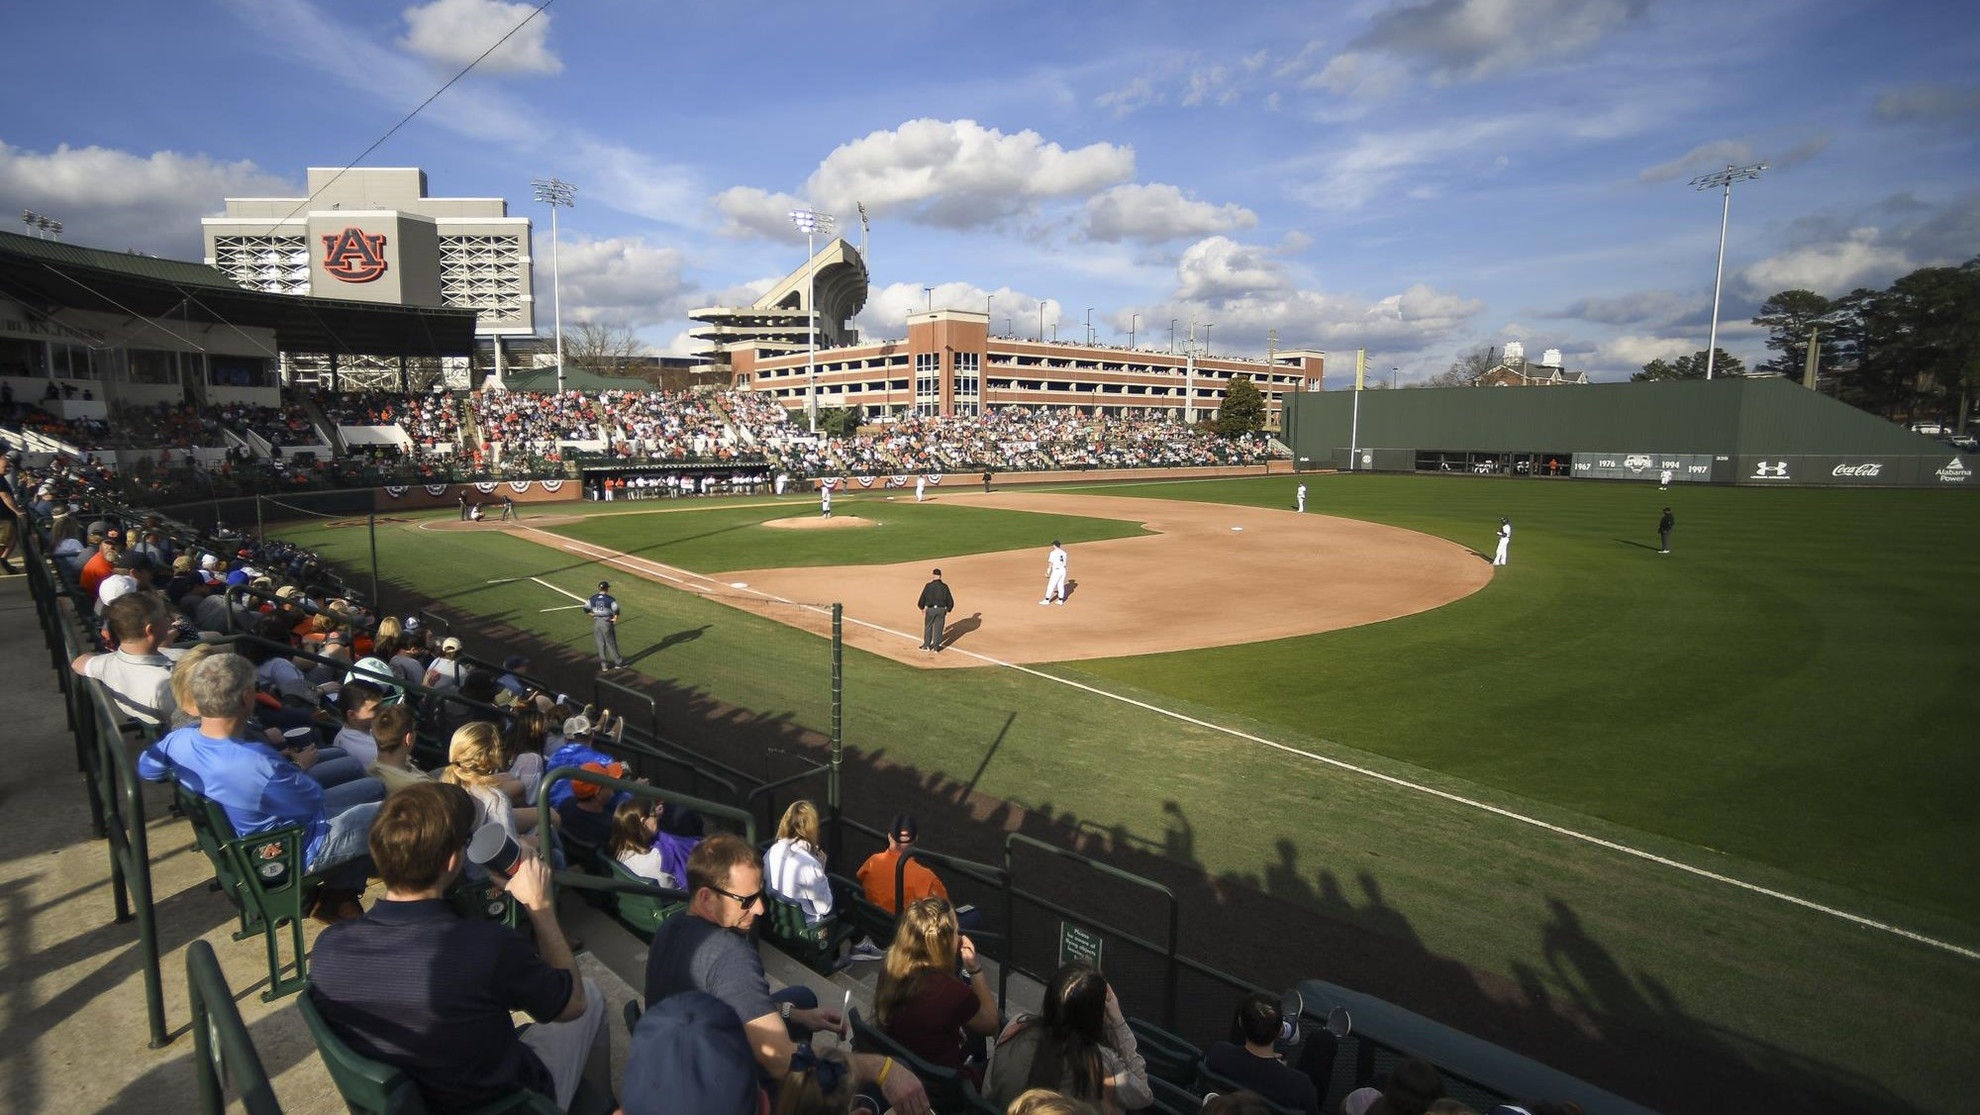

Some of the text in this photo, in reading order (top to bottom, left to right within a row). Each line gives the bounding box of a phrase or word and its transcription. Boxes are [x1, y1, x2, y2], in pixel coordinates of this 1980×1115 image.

[1574, 463, 1591, 471] 1967
[1599, 460, 1616, 468] 1976
[1661, 461, 1680, 469] 1994
[1688, 465, 1708, 474] 1997
[1074, 937, 1089, 946] aware
